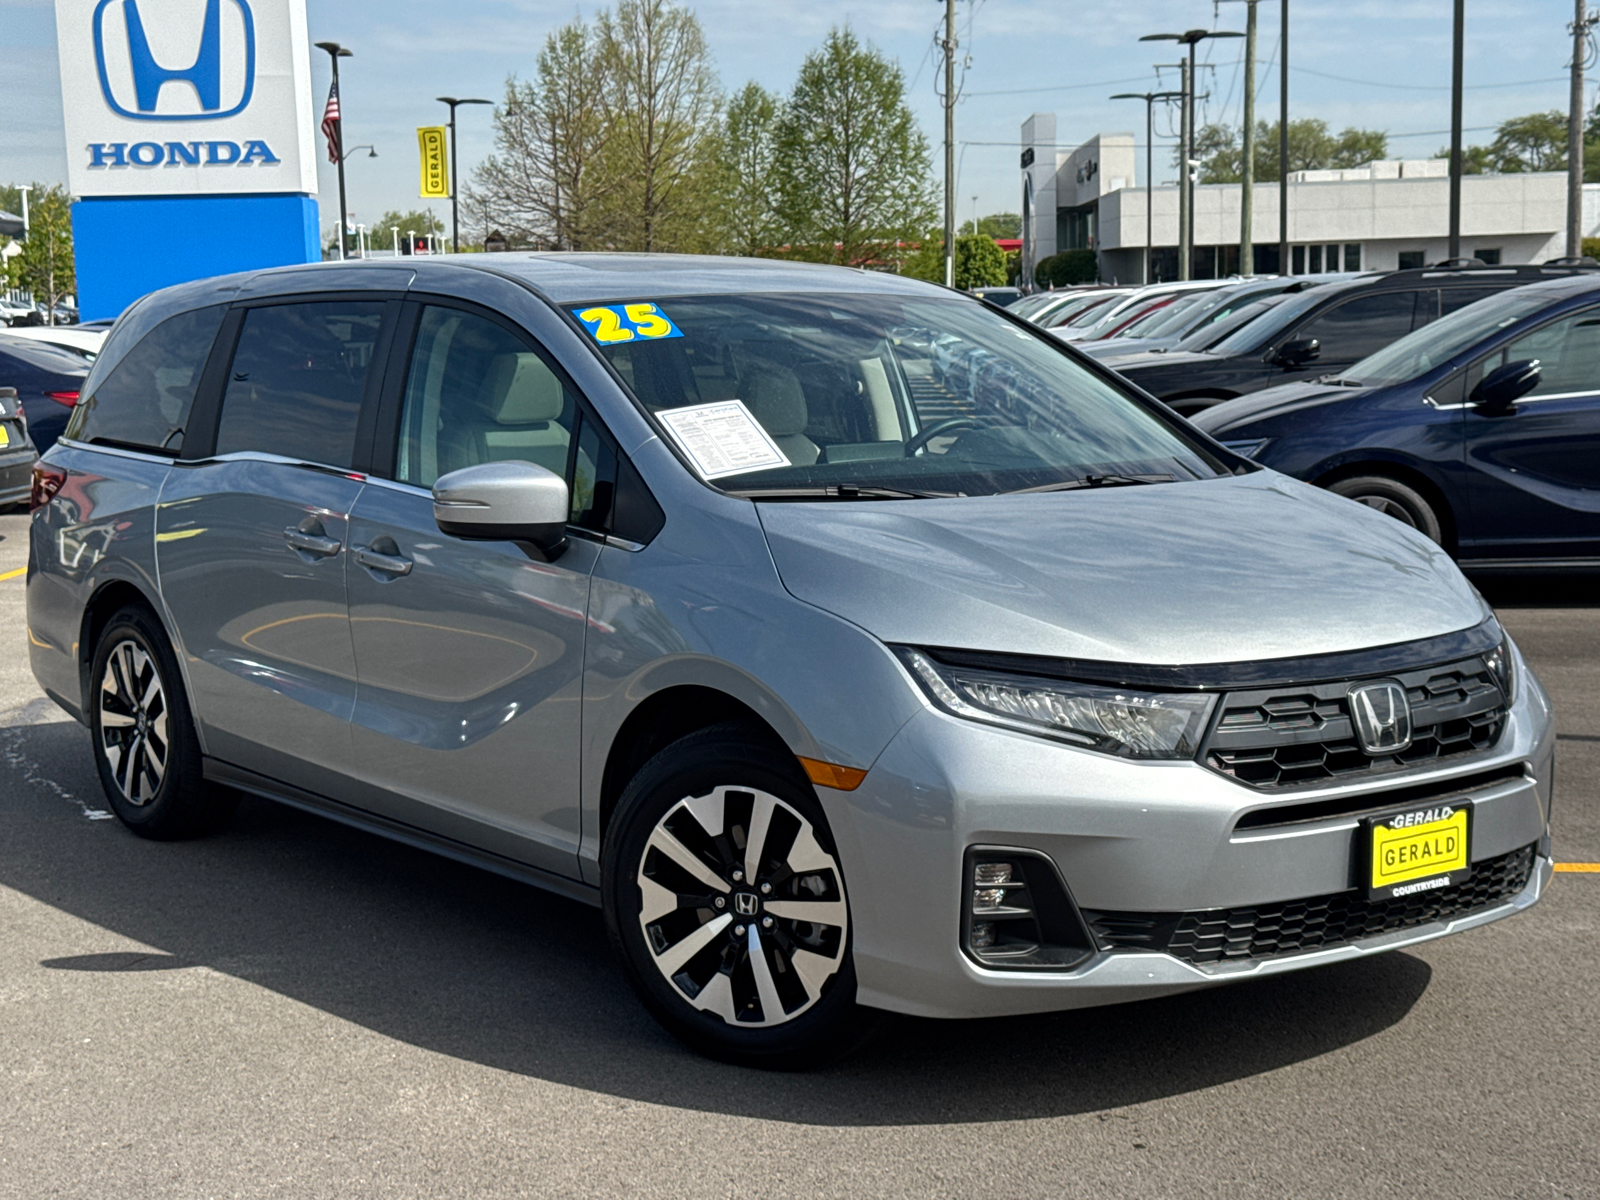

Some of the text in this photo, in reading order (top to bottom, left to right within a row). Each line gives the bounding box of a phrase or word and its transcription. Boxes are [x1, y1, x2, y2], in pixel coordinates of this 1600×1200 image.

[87, 139, 281, 169] HONDA
[428, 135, 440, 189] GERALD
[579, 303, 672, 342] 25
[1393, 805, 1452, 829] GERALD
[1385, 836, 1455, 867] GERALD
[1392, 876, 1451, 898] COUNTRYSIDE
